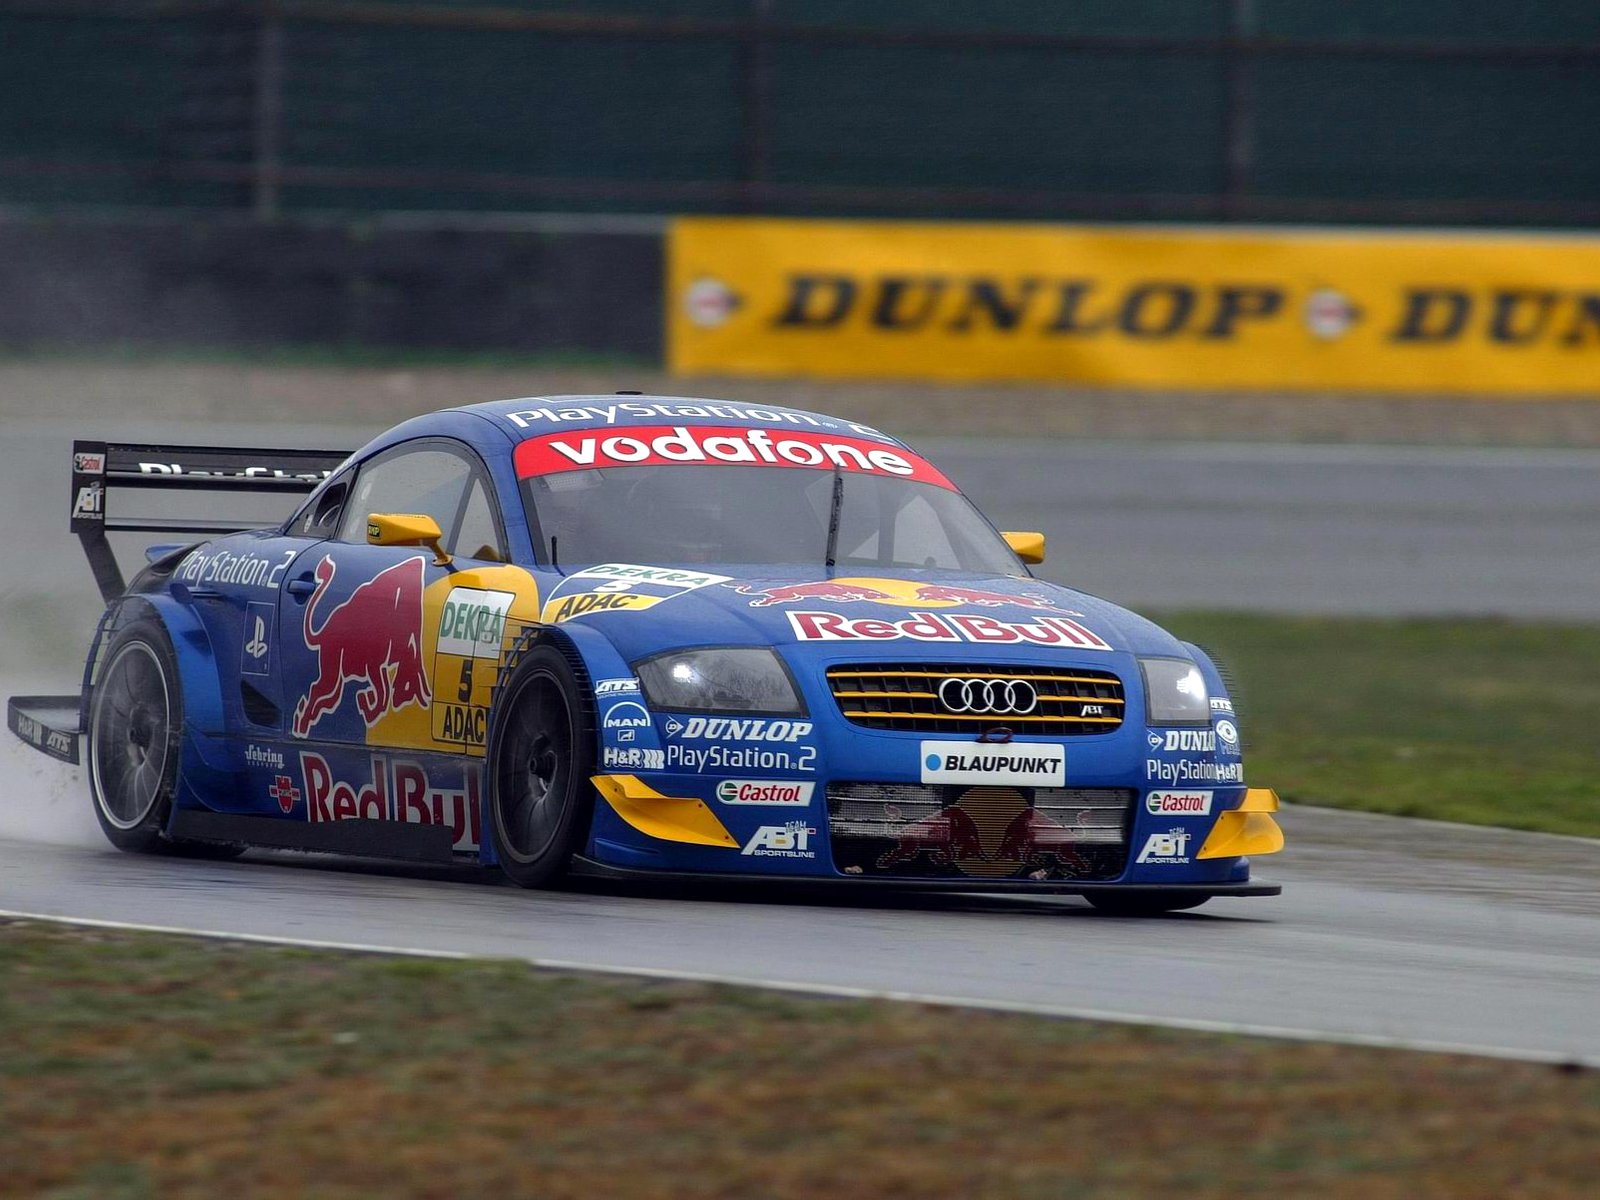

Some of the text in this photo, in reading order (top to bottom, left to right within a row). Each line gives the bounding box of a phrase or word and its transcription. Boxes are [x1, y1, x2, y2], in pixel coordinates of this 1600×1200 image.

[766, 272, 1285, 342] DUNLOP
[505, 402, 821, 428] PlayStation
[548, 427, 914, 476] vodafone
[173, 550, 269, 588] PlayStation
[584, 566, 710, 585] DEKRA
[440, 601, 502, 644] DEKRA
[555, 594, 638, 623] ADAC
[790, 611, 1108, 648] Red Bull
[458, 659, 473, 702] 5
[595, 680, 639, 693] ATS
[442, 705, 485, 743] ADAC
[607, 718, 647, 728] MAN
[1081, 705, 1104, 716] ABT
[681, 718, 813, 742] DUNLOP
[604, 747, 642, 768] H&R
[667, 745, 789, 773] PlayStation
[945, 756, 1062, 774] BLAUPUNKT
[301, 751, 389, 824] Red
[738, 784, 801, 802] Castrol
[1162, 794, 1205, 811] Castrol
[740, 826, 809, 855] ABT
[754, 849, 815, 859] SPORTSLINE
[1135, 833, 1187, 863] ABT
